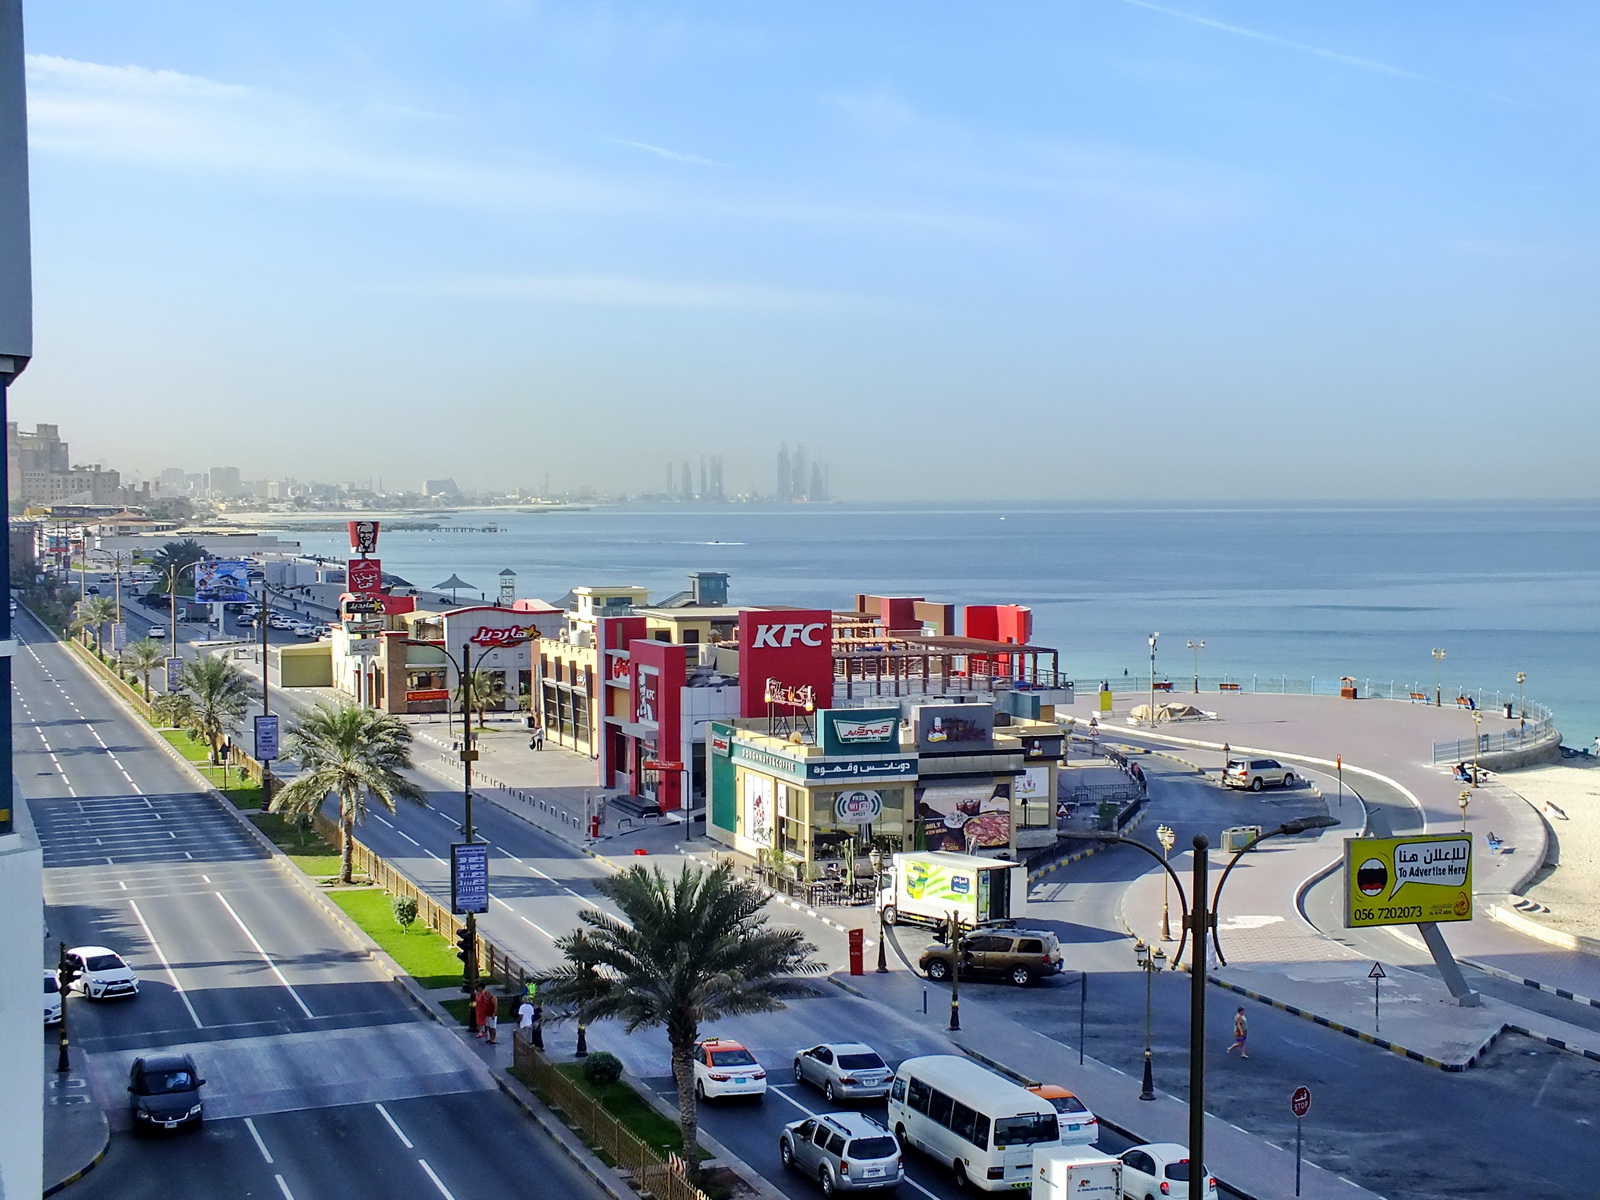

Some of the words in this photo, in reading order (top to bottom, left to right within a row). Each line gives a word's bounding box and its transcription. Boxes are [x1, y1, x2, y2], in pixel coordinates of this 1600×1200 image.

[351, 573, 378, 584] بيتزا
[474, 626, 528, 643] هارديز
[752, 622, 824, 648] KFC
[646, 688, 655, 701] KFC
[1399, 850, 1418, 863] هنا
[1424, 847, 1466, 865] للإعلان
[1399, 867, 1407, 878] To
[1408, 865, 1446, 877] Advertise
[1448, 864, 1466, 875] Here
[1354, 908, 1375, 921] 056
[1378, 905, 1422, 919] 7202073
[1294, 1090, 1308, 1102] قف
[1294, 1100, 1309, 1112] STOP
